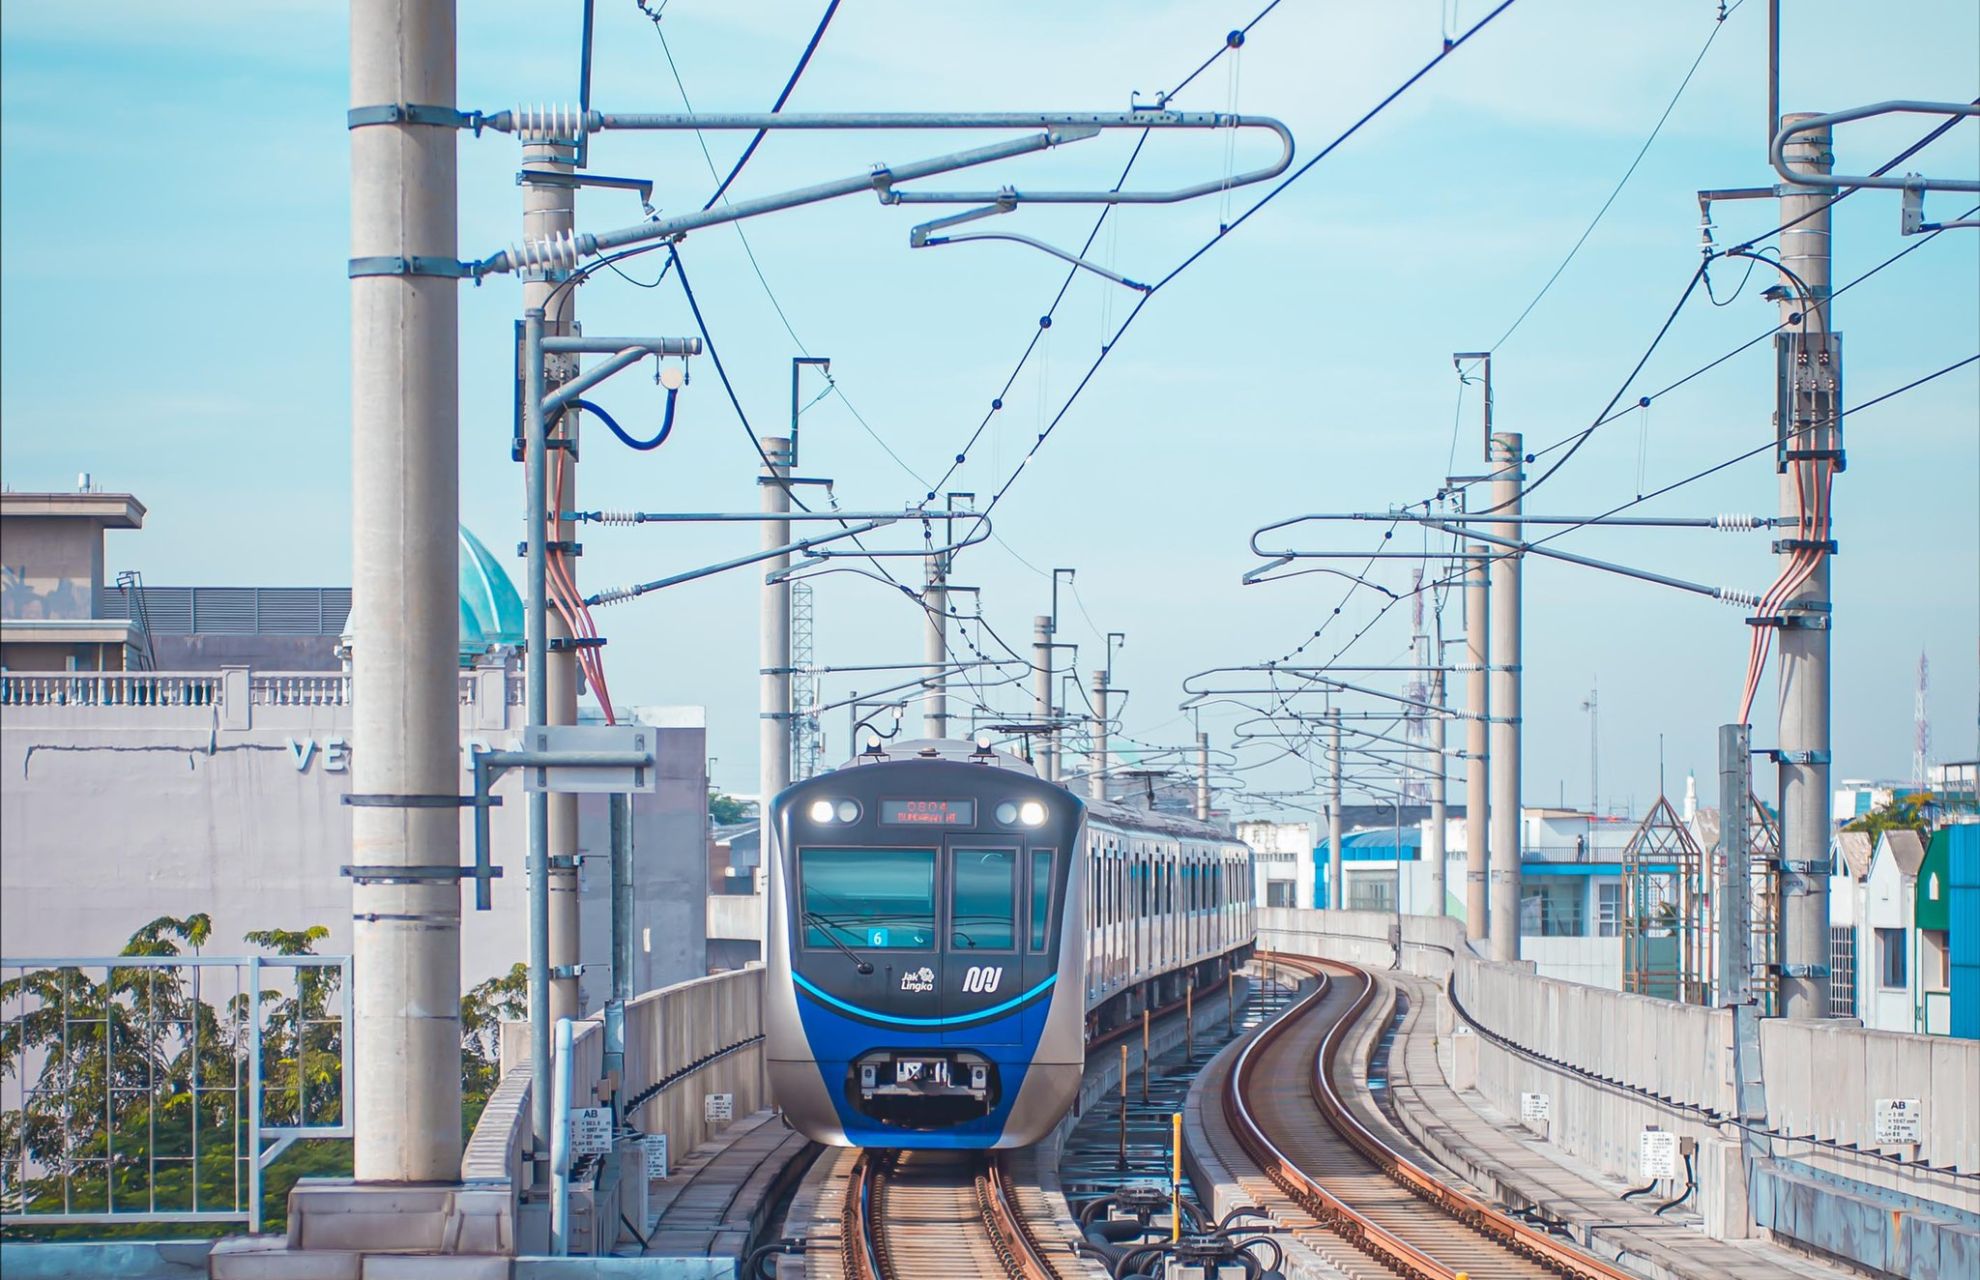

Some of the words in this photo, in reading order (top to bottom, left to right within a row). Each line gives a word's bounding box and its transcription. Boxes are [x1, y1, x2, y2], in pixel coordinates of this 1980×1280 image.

[873, 931, 882, 945] 6
[902, 971, 919, 981] Jak
[901, 980, 933, 993] Lingko
[1891, 1101, 1906, 1110] AB
[583, 1109, 599, 1119] AB
